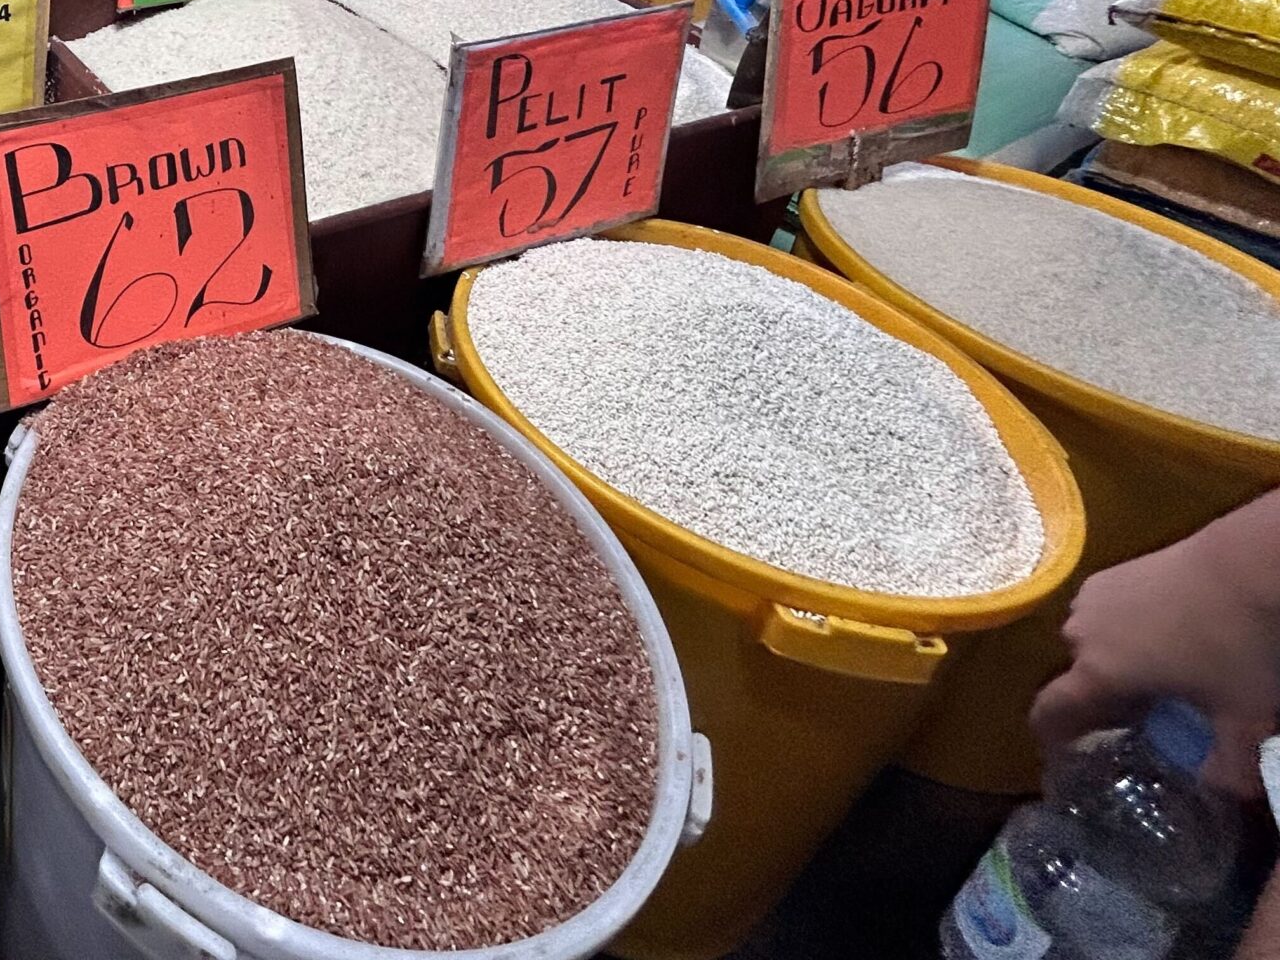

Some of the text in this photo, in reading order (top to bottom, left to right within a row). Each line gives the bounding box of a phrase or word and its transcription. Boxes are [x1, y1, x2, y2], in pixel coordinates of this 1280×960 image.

[485, 52, 627, 140] PELIT
[806, 15, 944, 129] 56
[3, 137, 247, 235] BROWN
[483, 121, 619, 239] 57
[622, 106, 648, 198] PURE
[18, 243, 53, 392] ORGANIC
[79, 187, 273, 349] 62
